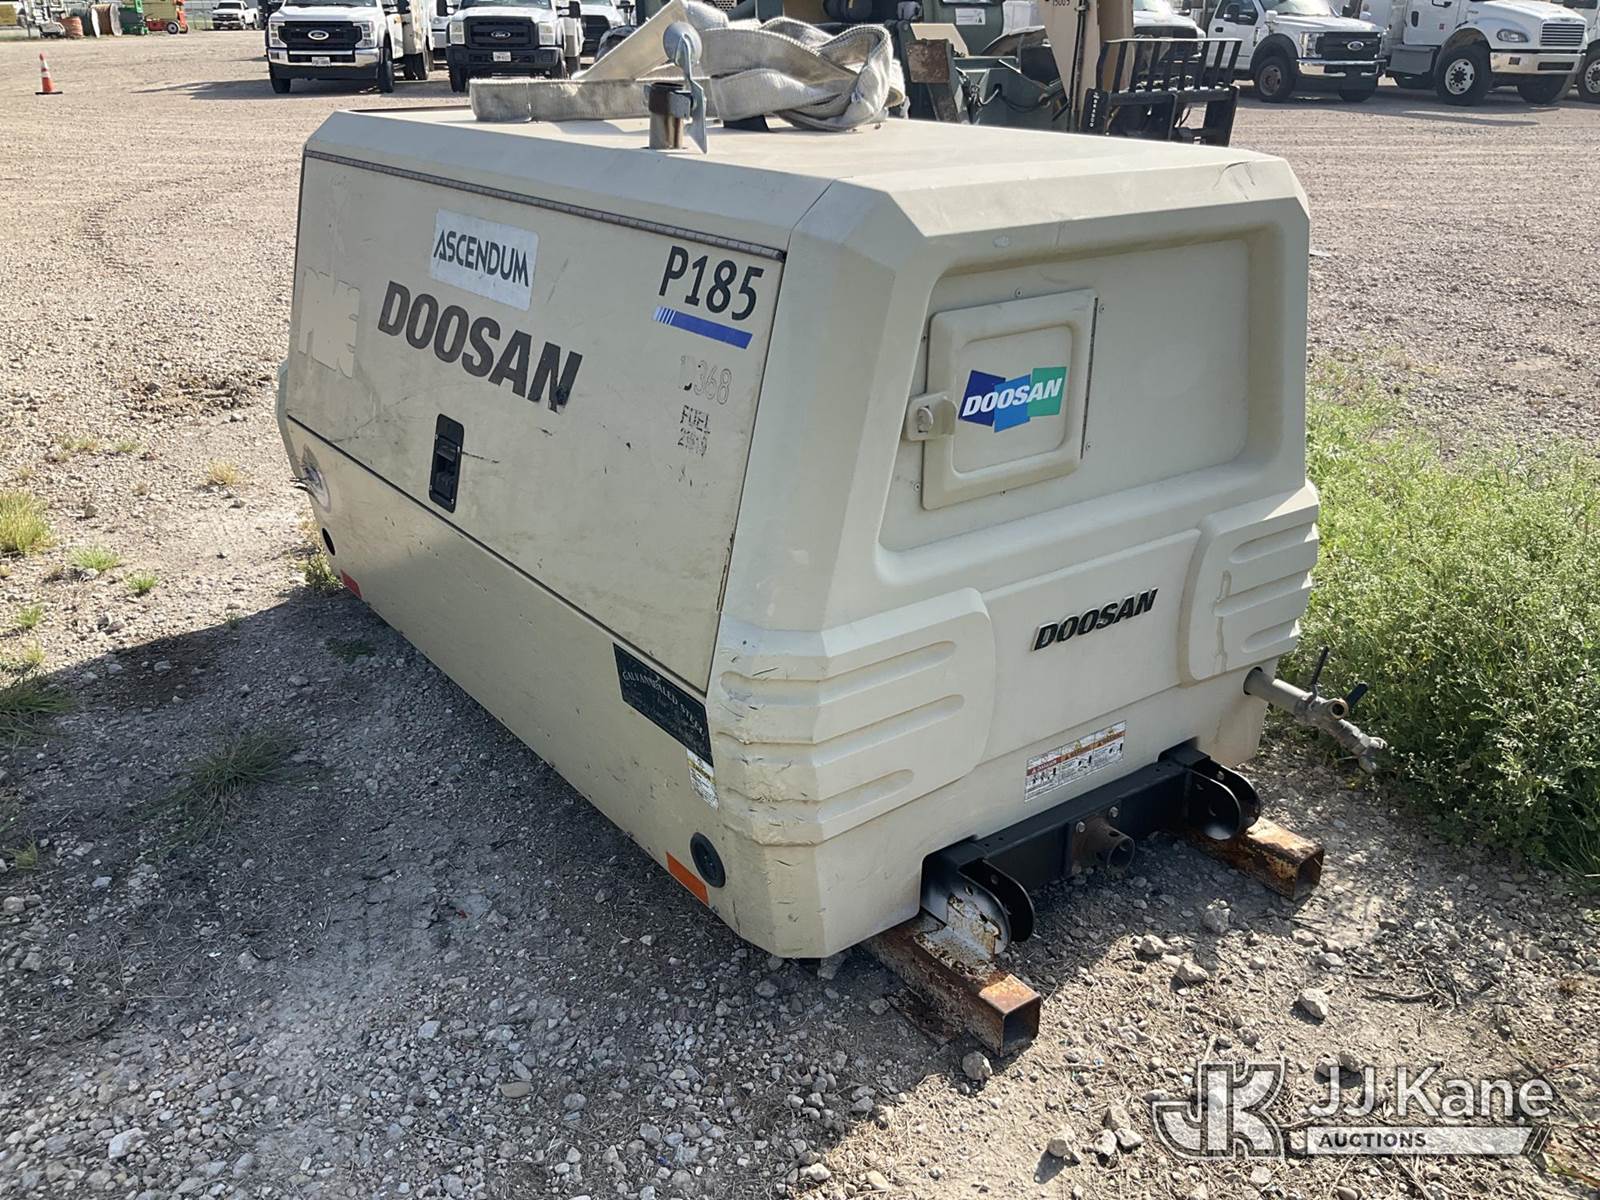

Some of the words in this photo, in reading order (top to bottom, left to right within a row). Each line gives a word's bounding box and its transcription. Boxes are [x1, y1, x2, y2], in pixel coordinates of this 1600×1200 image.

[433, 230, 530, 287] ASCENDUM
[658, 246, 765, 321] P185
[377, 280, 583, 414] DOOSAN
[962, 377, 1062, 417] DOOSAN
[1031, 587, 1159, 651] DOOSAN
